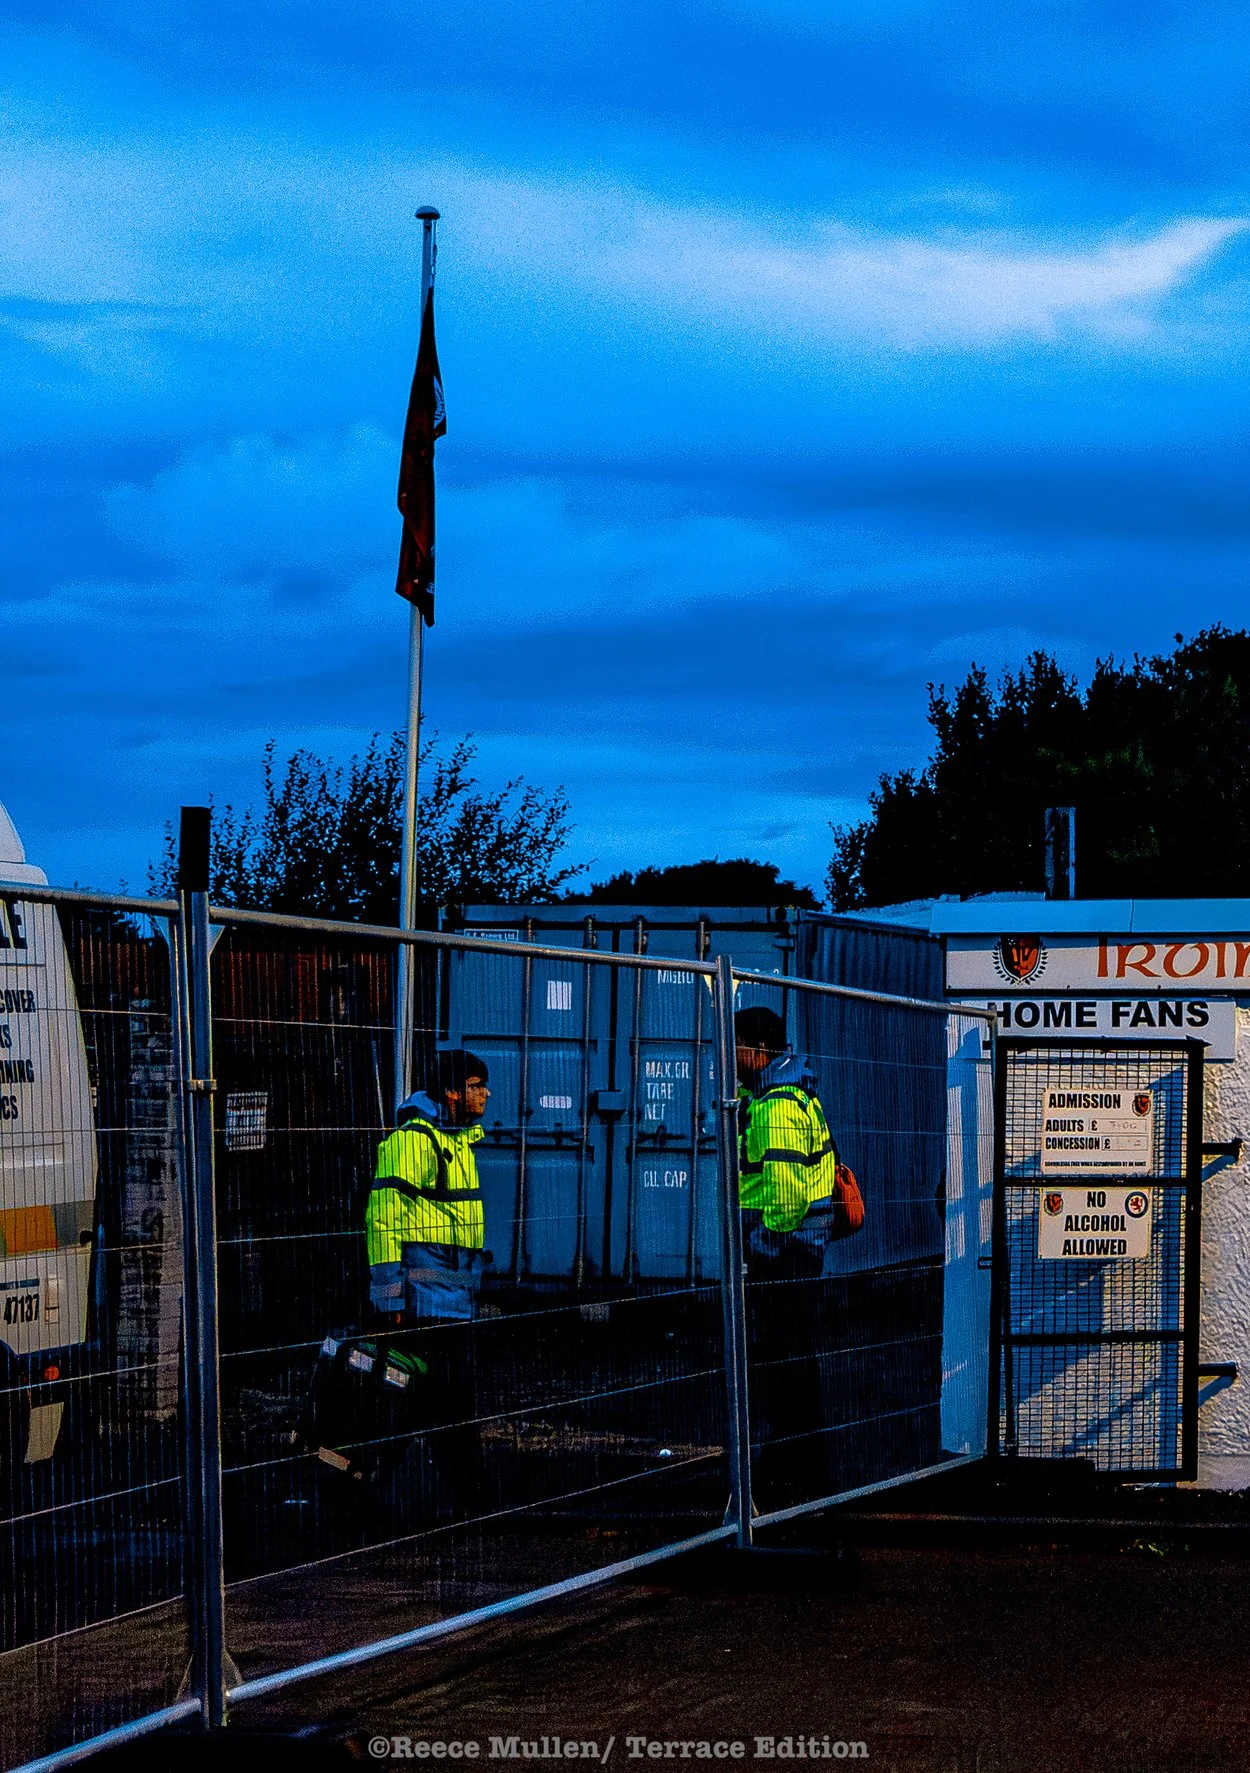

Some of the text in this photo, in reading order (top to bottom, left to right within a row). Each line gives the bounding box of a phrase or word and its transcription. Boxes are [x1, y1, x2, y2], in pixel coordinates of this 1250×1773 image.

[988, 1001, 1210, 1029] HOME FANS
[1048, 1094, 1121, 1110] ADMISSION
[1045, 1119, 1085, 1132] ADULTS
[1045, 1137, 1100, 1150] CONCESSION
[1087, 1191, 1107, 1208] NO
[1064, 1215, 1127, 1232] ALCOHOL
[1062, 1239, 1127, 1256] ALLOWED
